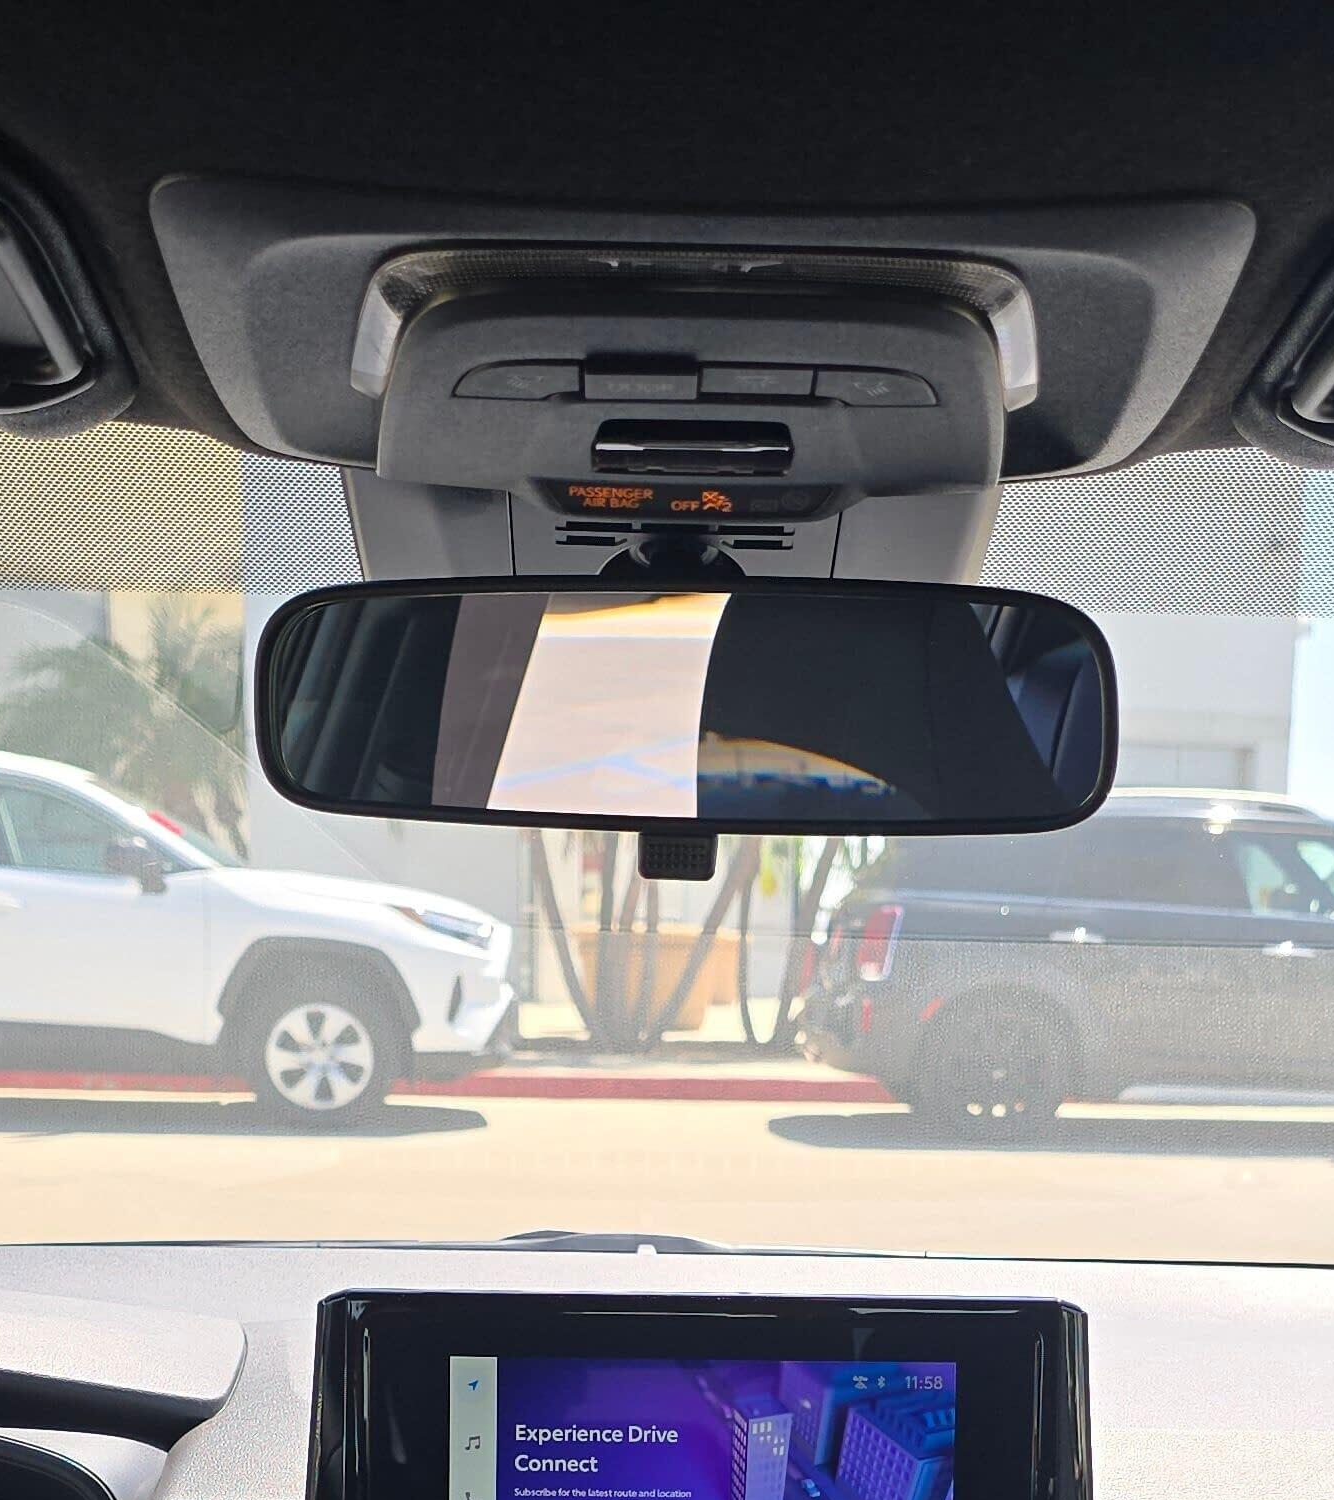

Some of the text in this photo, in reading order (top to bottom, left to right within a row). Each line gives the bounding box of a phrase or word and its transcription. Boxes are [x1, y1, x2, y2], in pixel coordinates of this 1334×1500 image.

[568, 485, 653, 500] PASSENGER
[582, 497, 640, 509] AIR BAG
[671, 500, 700, 511] OFF
[905, 1374, 944, 1391] 11:58
[514, 1423, 679, 1447] Experience Drive
[514, 1454, 599, 1474] Connect
[514, 1488, 692, 1499] Subscribe for the latest route and location
